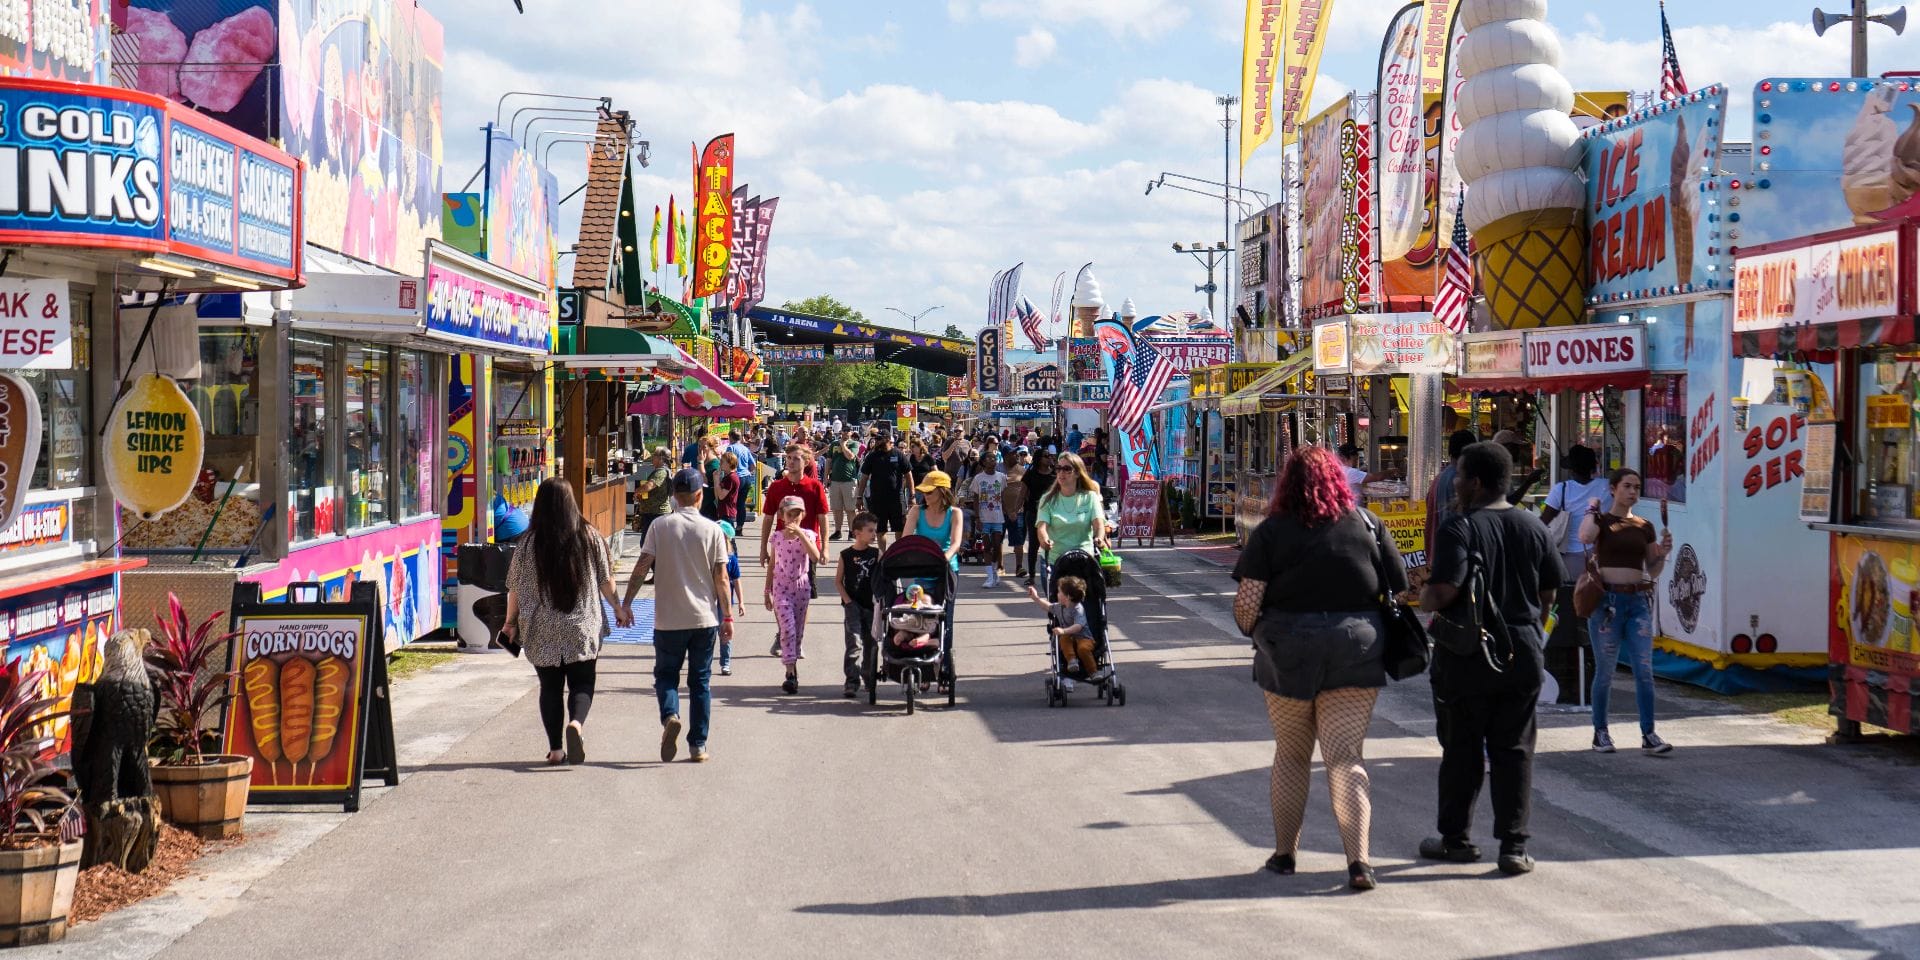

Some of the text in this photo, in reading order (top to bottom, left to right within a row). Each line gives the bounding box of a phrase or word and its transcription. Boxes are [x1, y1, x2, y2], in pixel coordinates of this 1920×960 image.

[1283, 66, 1307, 134] TEA
[24, 106, 135, 146] COLD
[171, 130, 233, 198] CHICKEN
[1594, 128, 1643, 213] ICE
[239, 156, 291, 227] SAUSAGE
[171, 191, 232, 243] ON-A-STICK
[703, 167, 728, 291] TACOS
[1590, 195, 1665, 284] REAM
[1837, 242, 1895, 310] CHICKEN
[42, 293, 59, 318] &
[789, 317, 818, 328] ARENA
[1358, 322, 1447, 335] Ice Cold Milk
[0, 329, 56, 355] ESE
[1187, 346, 1226, 362] BEER
[1381, 338, 1424, 348] Coffee
[1529, 341, 1550, 366] DIP
[1556, 336, 1634, 365] CONES
[982, 332, 996, 389] GYROS
[1169, 356, 1210, 371] OATS
[1384, 352, 1424, 363] Water
[1026, 379, 1056, 389] GYR
[58, 410, 78, 425] CASH
[127, 411, 187, 431] LEMON
[1691, 392, 1715, 446] SOFT
[127, 433, 185, 452] SHAKE
[1744, 414, 1807, 458] SOF
[138, 455, 172, 474] UPS
[1691, 424, 1719, 484] SERVE
[1744, 449, 1804, 497] SER
[1384, 519, 1426, 528] RANDMA'S
[1391, 529, 1425, 539] OCOLAT
[247, 631, 355, 658] CORN DOGS
